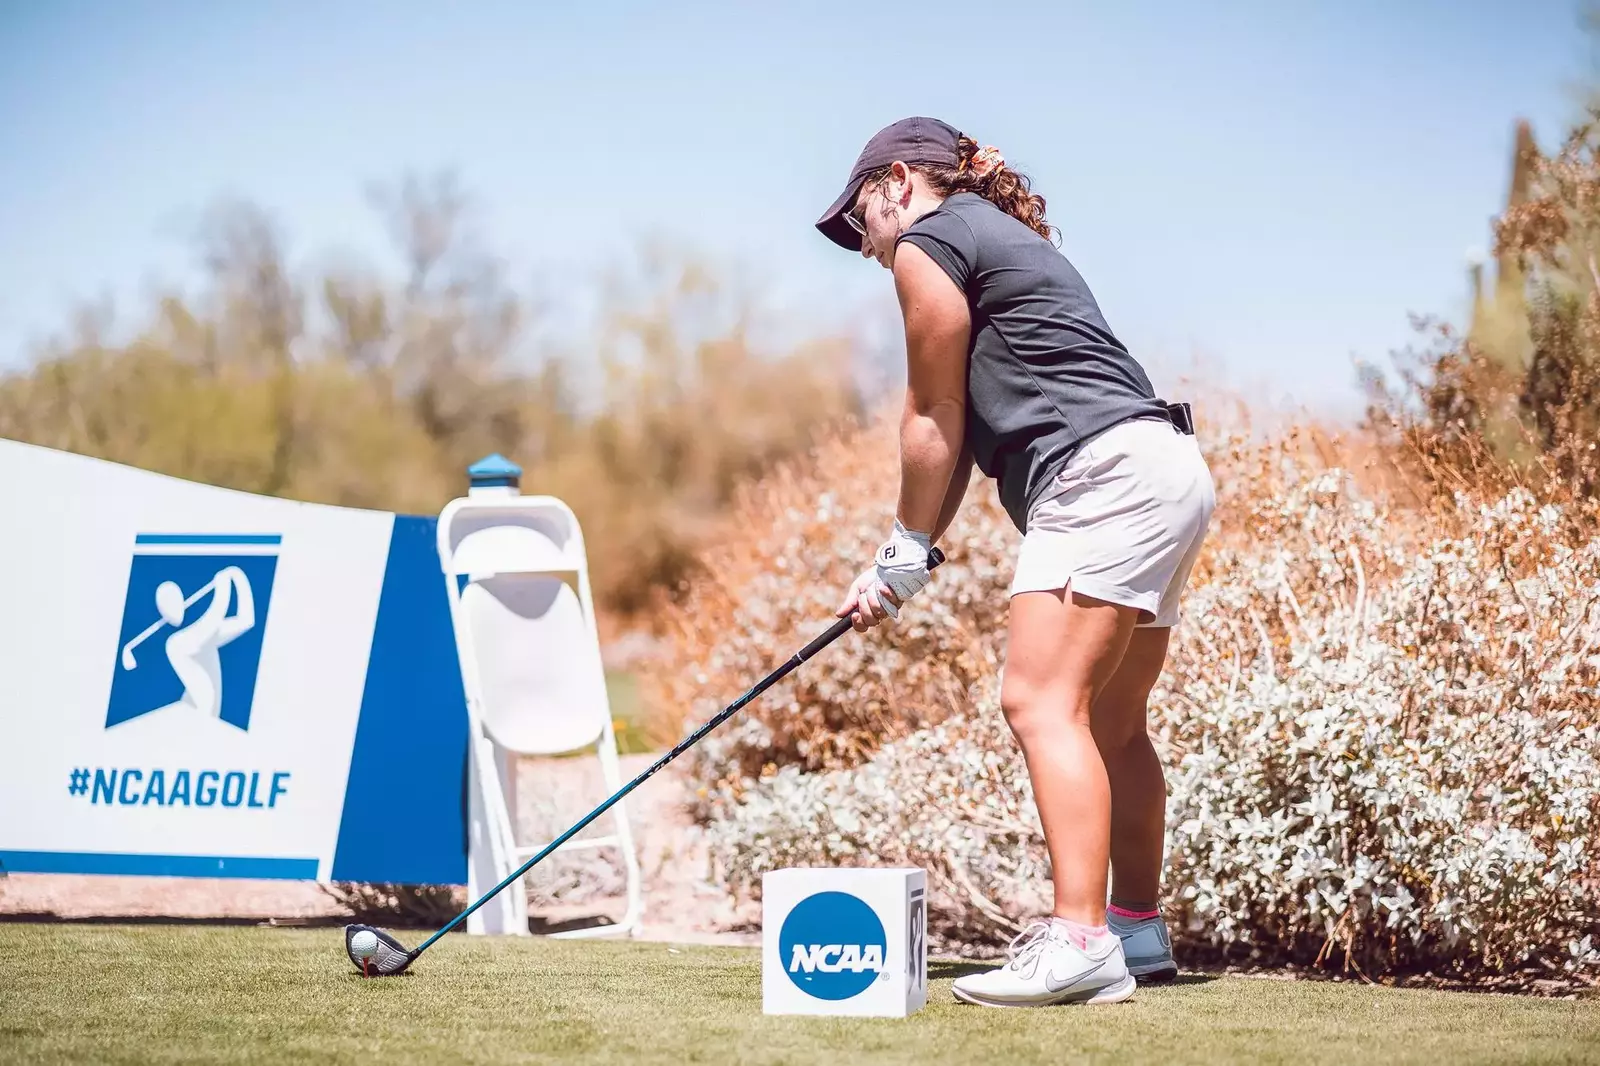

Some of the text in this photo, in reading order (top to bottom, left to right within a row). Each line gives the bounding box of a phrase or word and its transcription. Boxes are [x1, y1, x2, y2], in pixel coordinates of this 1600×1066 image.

[884, 545, 896, 560] FJ
[68, 768, 291, 808] #NCAAGOLF
[789, 944, 883, 973] NCAA
